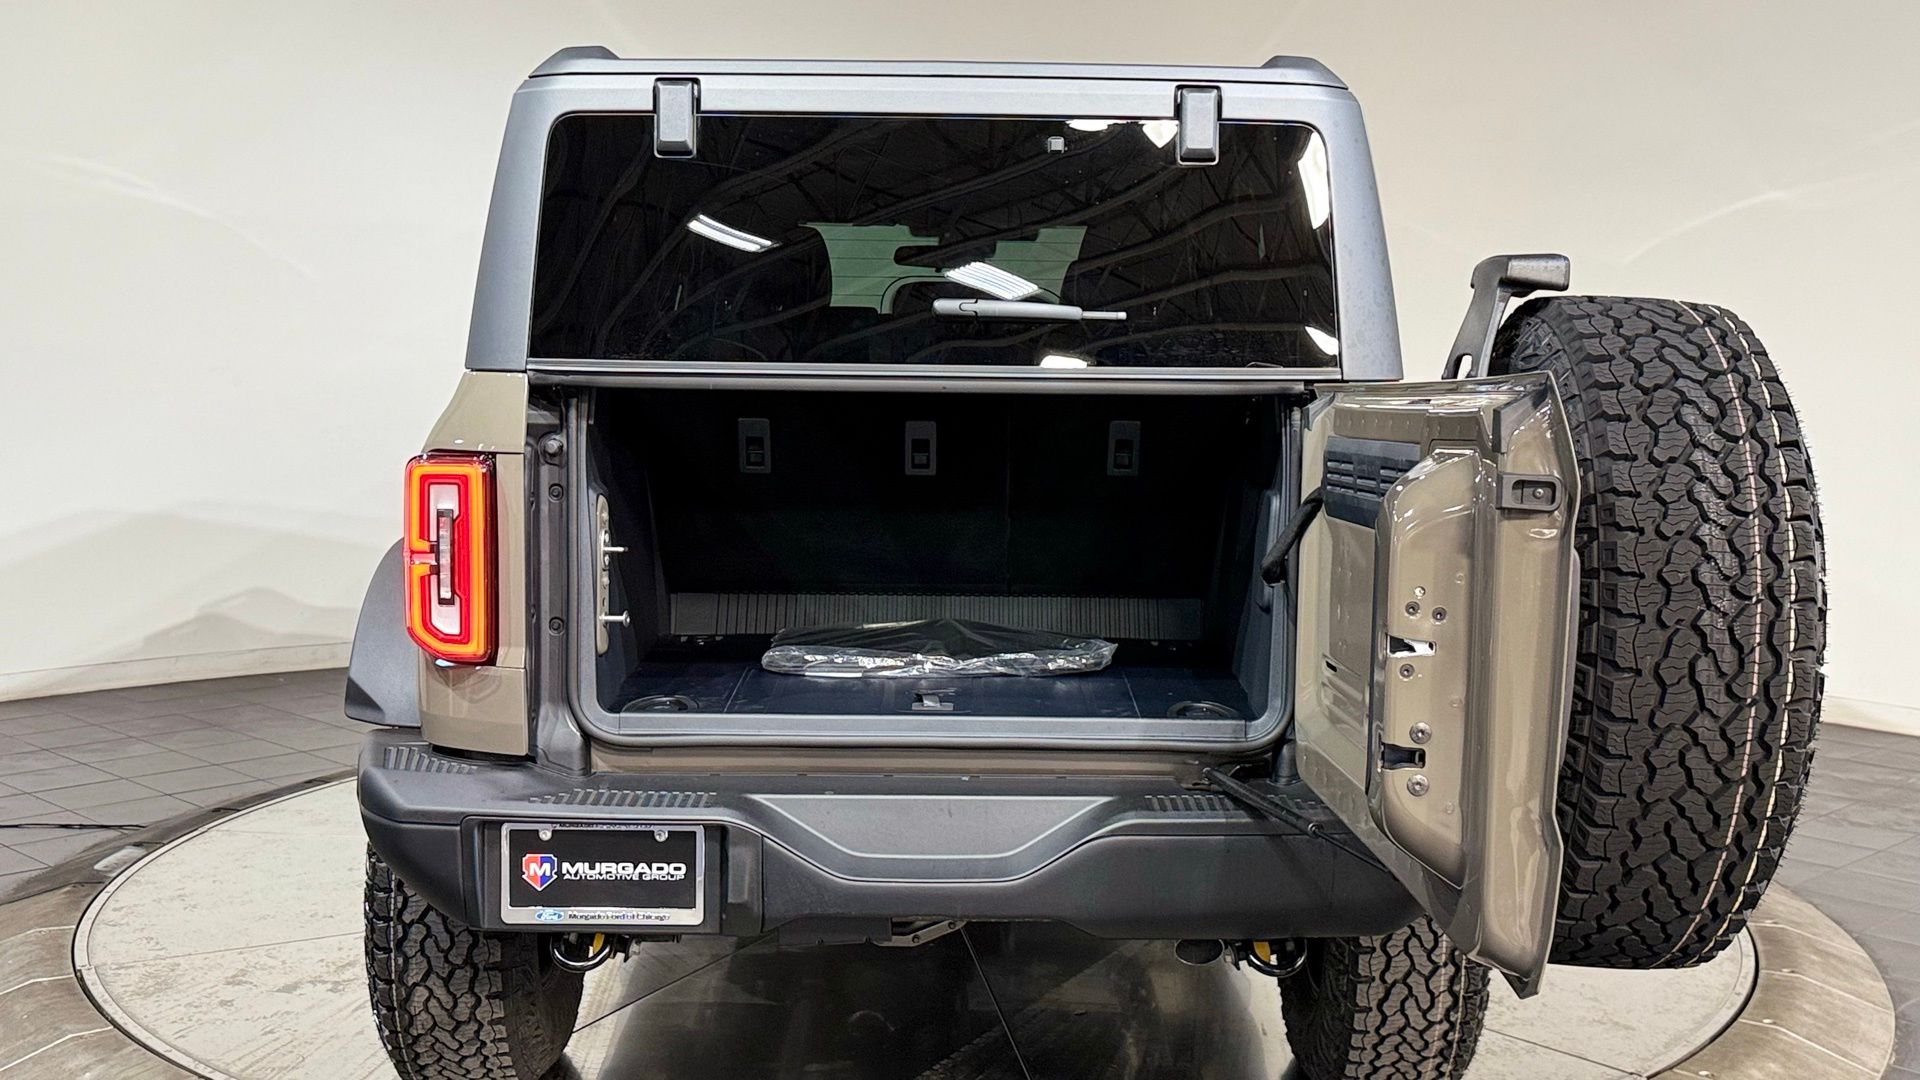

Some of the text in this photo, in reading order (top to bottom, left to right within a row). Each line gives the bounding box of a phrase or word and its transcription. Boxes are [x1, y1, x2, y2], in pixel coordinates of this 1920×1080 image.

[561, 862, 687, 875] MURGADO
[563, 873, 686, 881] AUTOMOTIVE GROUP
